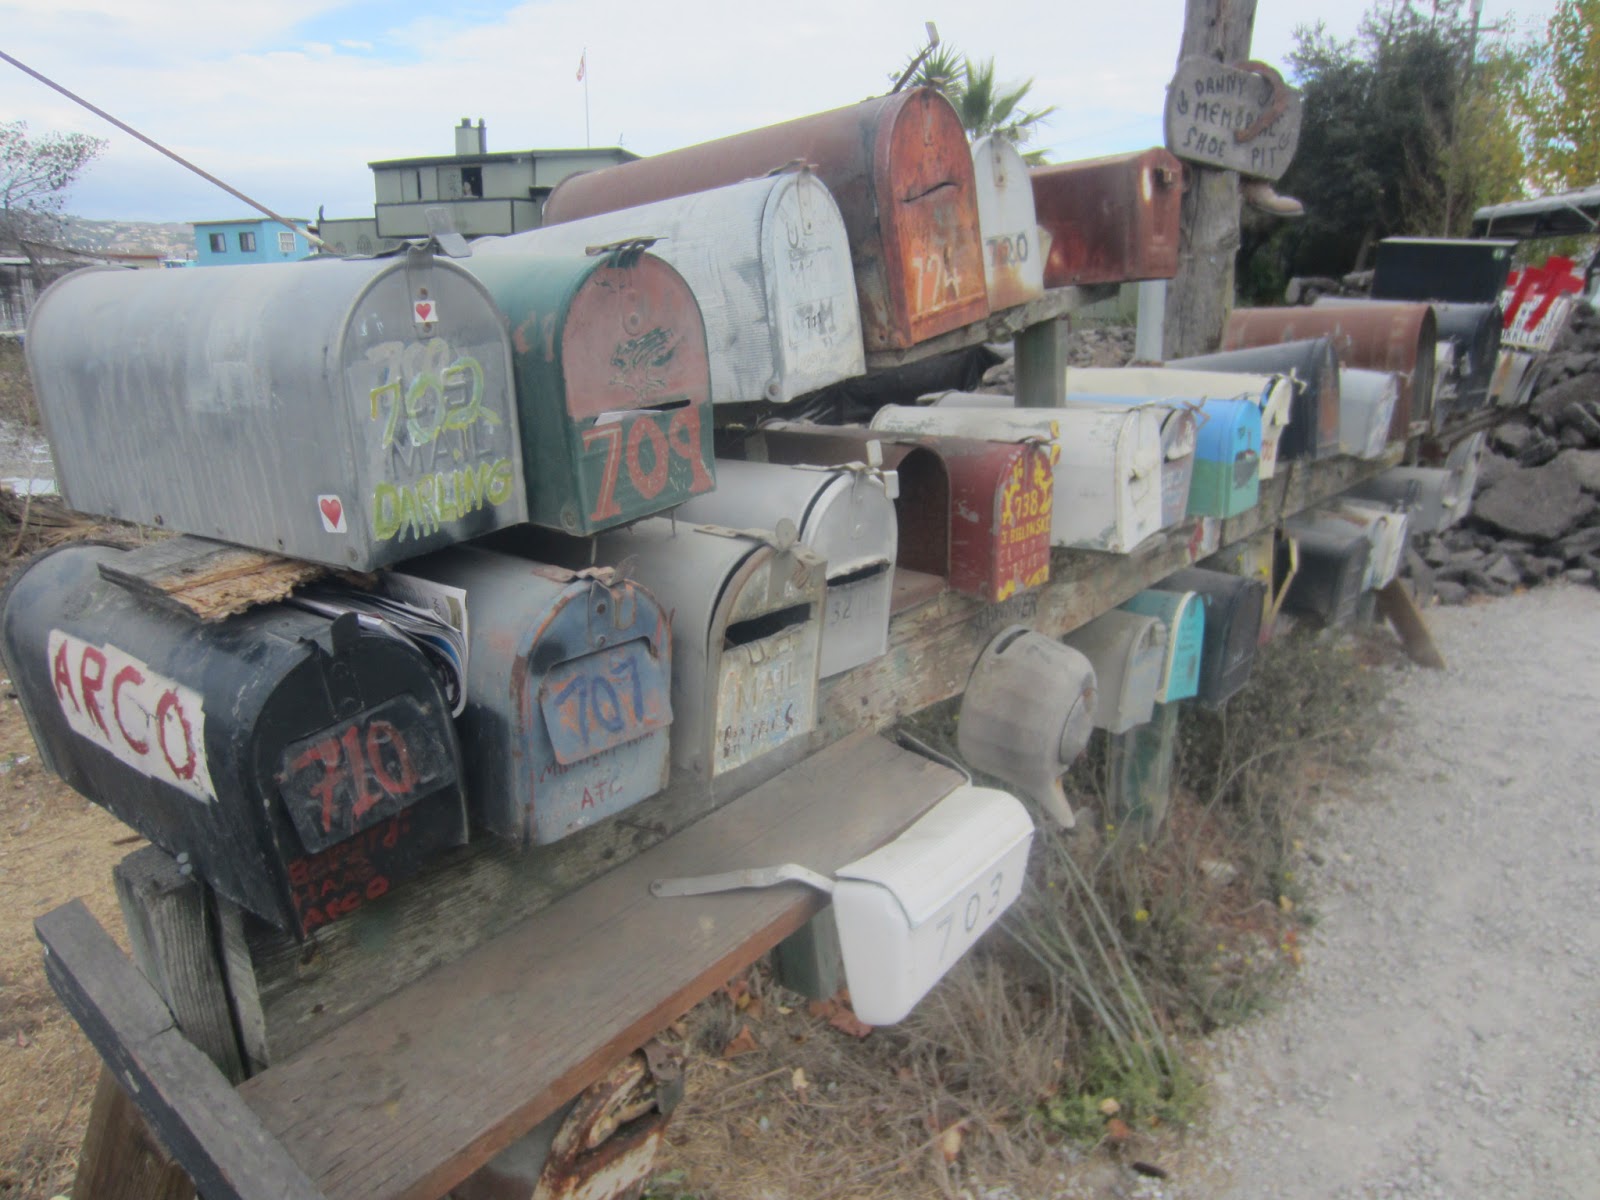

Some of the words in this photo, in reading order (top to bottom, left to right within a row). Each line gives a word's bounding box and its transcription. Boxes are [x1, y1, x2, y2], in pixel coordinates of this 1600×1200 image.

[1195, 75, 1247, 96] DANNY
[1182, 126, 1227, 158] SHOE
[1252, 147, 1277, 168] PIT
[372, 458, 513, 541] DARLING
[582, 402, 715, 522] 709
[1014, 489, 1039, 520] 738
[54, 639, 197, 780] ARCO
[553, 655, 644, 746] 707
[292, 720, 420, 833] 710
[935, 871, 1003, 962] 703
